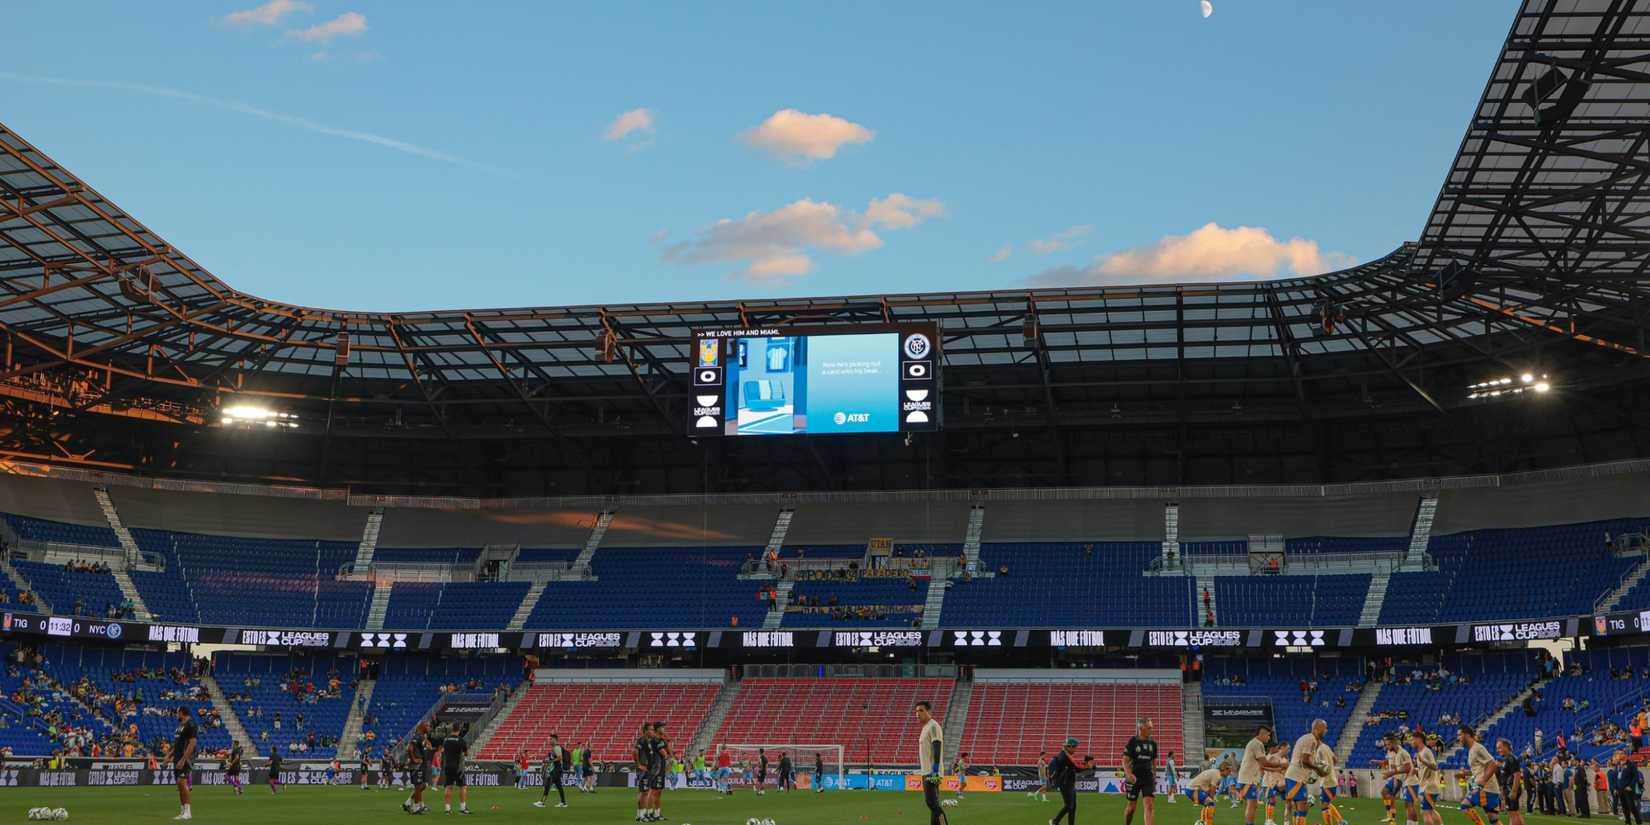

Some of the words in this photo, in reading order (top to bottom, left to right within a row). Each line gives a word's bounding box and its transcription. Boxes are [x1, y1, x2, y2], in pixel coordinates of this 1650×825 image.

[700, 371, 716, 382] 0
[909, 365, 925, 376] 0
[847, 413, 871, 422] AT&T
[14, 618, 28, 629] TIG
[40, 620, 46, 630] 0
[50, 620, 71, 632] 11:32
[74, 624, 80, 633] 0
[89, 625, 106, 634] NYC
[1515, 621, 1560, 632] LEAGUES
[1609, 619, 1625, 630] TIG
[1633, 617, 1639, 628] 0
[149, 625, 163, 641] MÁS
[163, 626, 176, 642] QUE
[176, 626, 199, 643] FÚTBOL
[242, 630, 259, 644] ESTO
[258, 631, 266, 645] ES
[281, 631, 329, 640] LEAGUES
[539, 633, 554, 647] ESTO
[554, 633, 561, 647] ES
[743, 631, 757, 647] MÁS
[757, 631, 770, 647] QUE
[770, 630, 794, 647] FÚTBOL
[835, 631, 851, 646] ESTO
[851, 631, 859, 646] ES
[874, 631, 922, 639] LEAGUES
[1050, 630, 1065, 646] MÁS
[1066, 631, 1079, 647] QUE
[1080, 630, 1104, 646] FÚTBOL
[1149, 631, 1165, 646] ESTO
[1165, 631, 1174, 646] ES
[1189, 631, 1240, 639] LEAGUES
[1376, 628, 1392, 645] MÁS
[1392, 628, 1407, 645] QUE
[1406, 626, 1432, 645] FÚTBOL
[1474, 625, 1492, 641] ESTO
[1491, 625, 1500, 640] ES
[451, 632, 465, 648] MÁS
[465, 633, 477, 649] QUE
[477, 632, 499, 648] FÚTBOL
[475, 772, 499, 786] FÚTBOL
